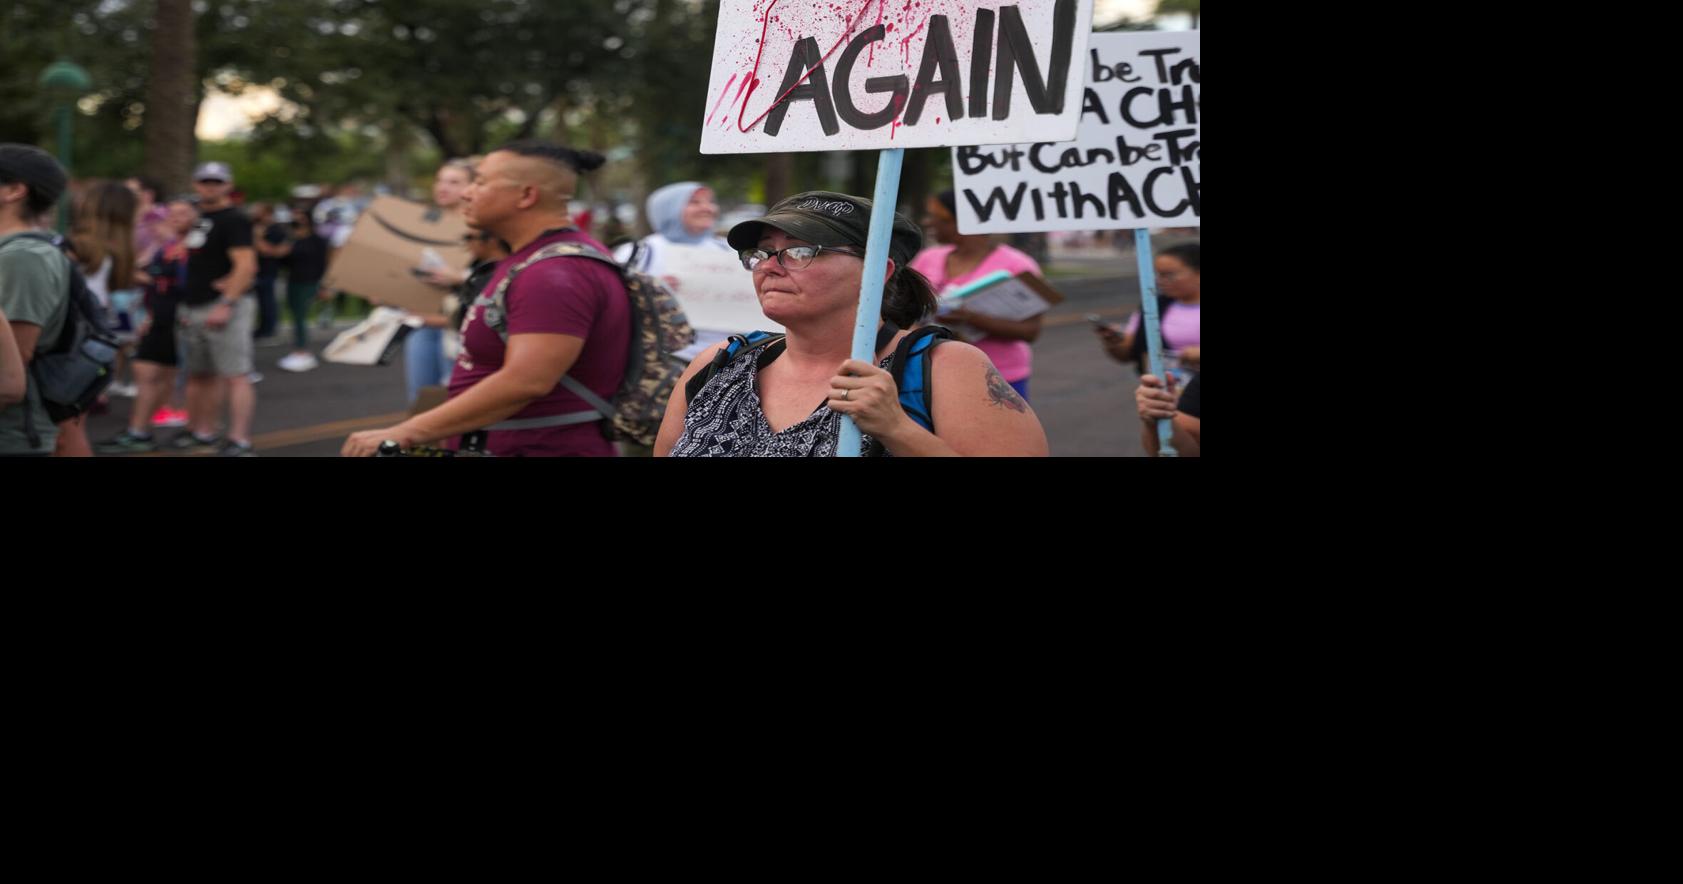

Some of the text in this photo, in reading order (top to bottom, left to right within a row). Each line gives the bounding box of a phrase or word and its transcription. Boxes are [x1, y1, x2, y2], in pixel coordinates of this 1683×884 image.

[763, 0, 1077, 137] AGAIN
[1090, 48, 1142, 83] be
[1081, 85, 1199, 129] A CH
[956, 128, 1199, 176] But Can be Tr
